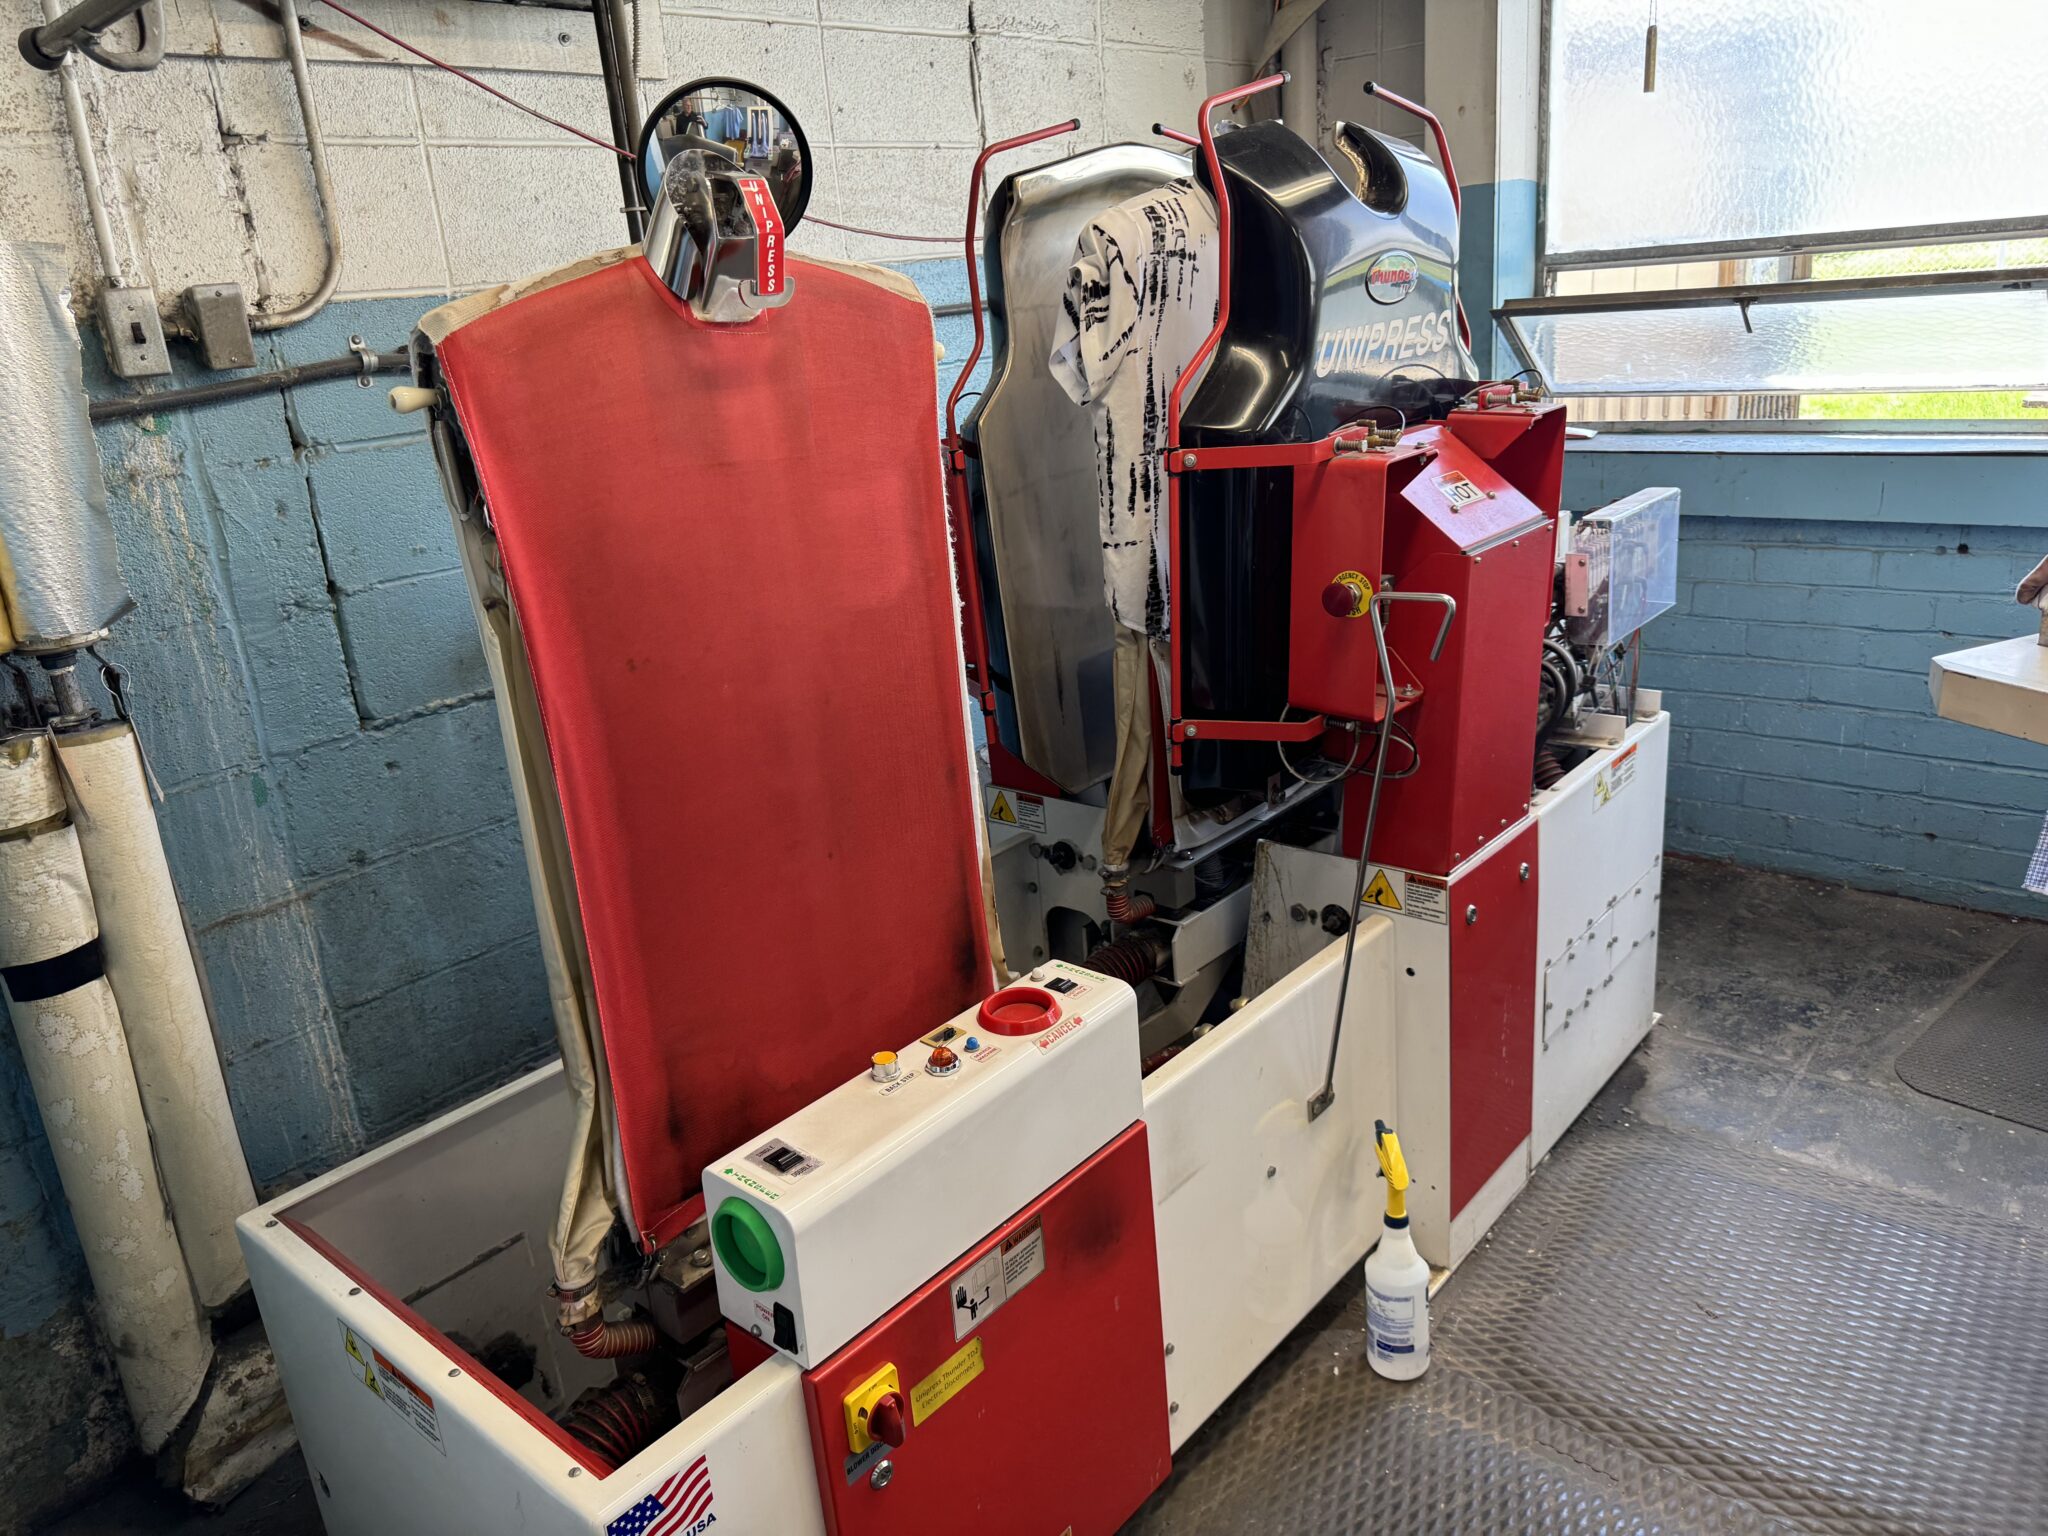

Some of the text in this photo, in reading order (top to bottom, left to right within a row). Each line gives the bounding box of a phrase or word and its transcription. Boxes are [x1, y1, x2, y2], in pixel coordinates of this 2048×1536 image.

[749, 181, 776, 292] UNIPRESS
[1316, 310, 1451, 378] UNIPRESS
[1445, 483, 1478, 503] HOT
[1334, 573, 1371, 590] ERGENCY STOP
[1046, 1020, 1077, 1044] CANCEL
[885, 1072, 915, 1093] BACK STEP
[791, 1163, 812, 1178] DOUBLE
[733, 1171, 780, 1200] TRANSFER
[915, 1379, 942, 1403] Unipress
[942, 1358, 967, 1381] Thunder
[922, 1361, 976, 1409] Electric Disconnect
[847, 1451, 870, 1476] BLOWER
[687, 1512, 717, 1536] USA
